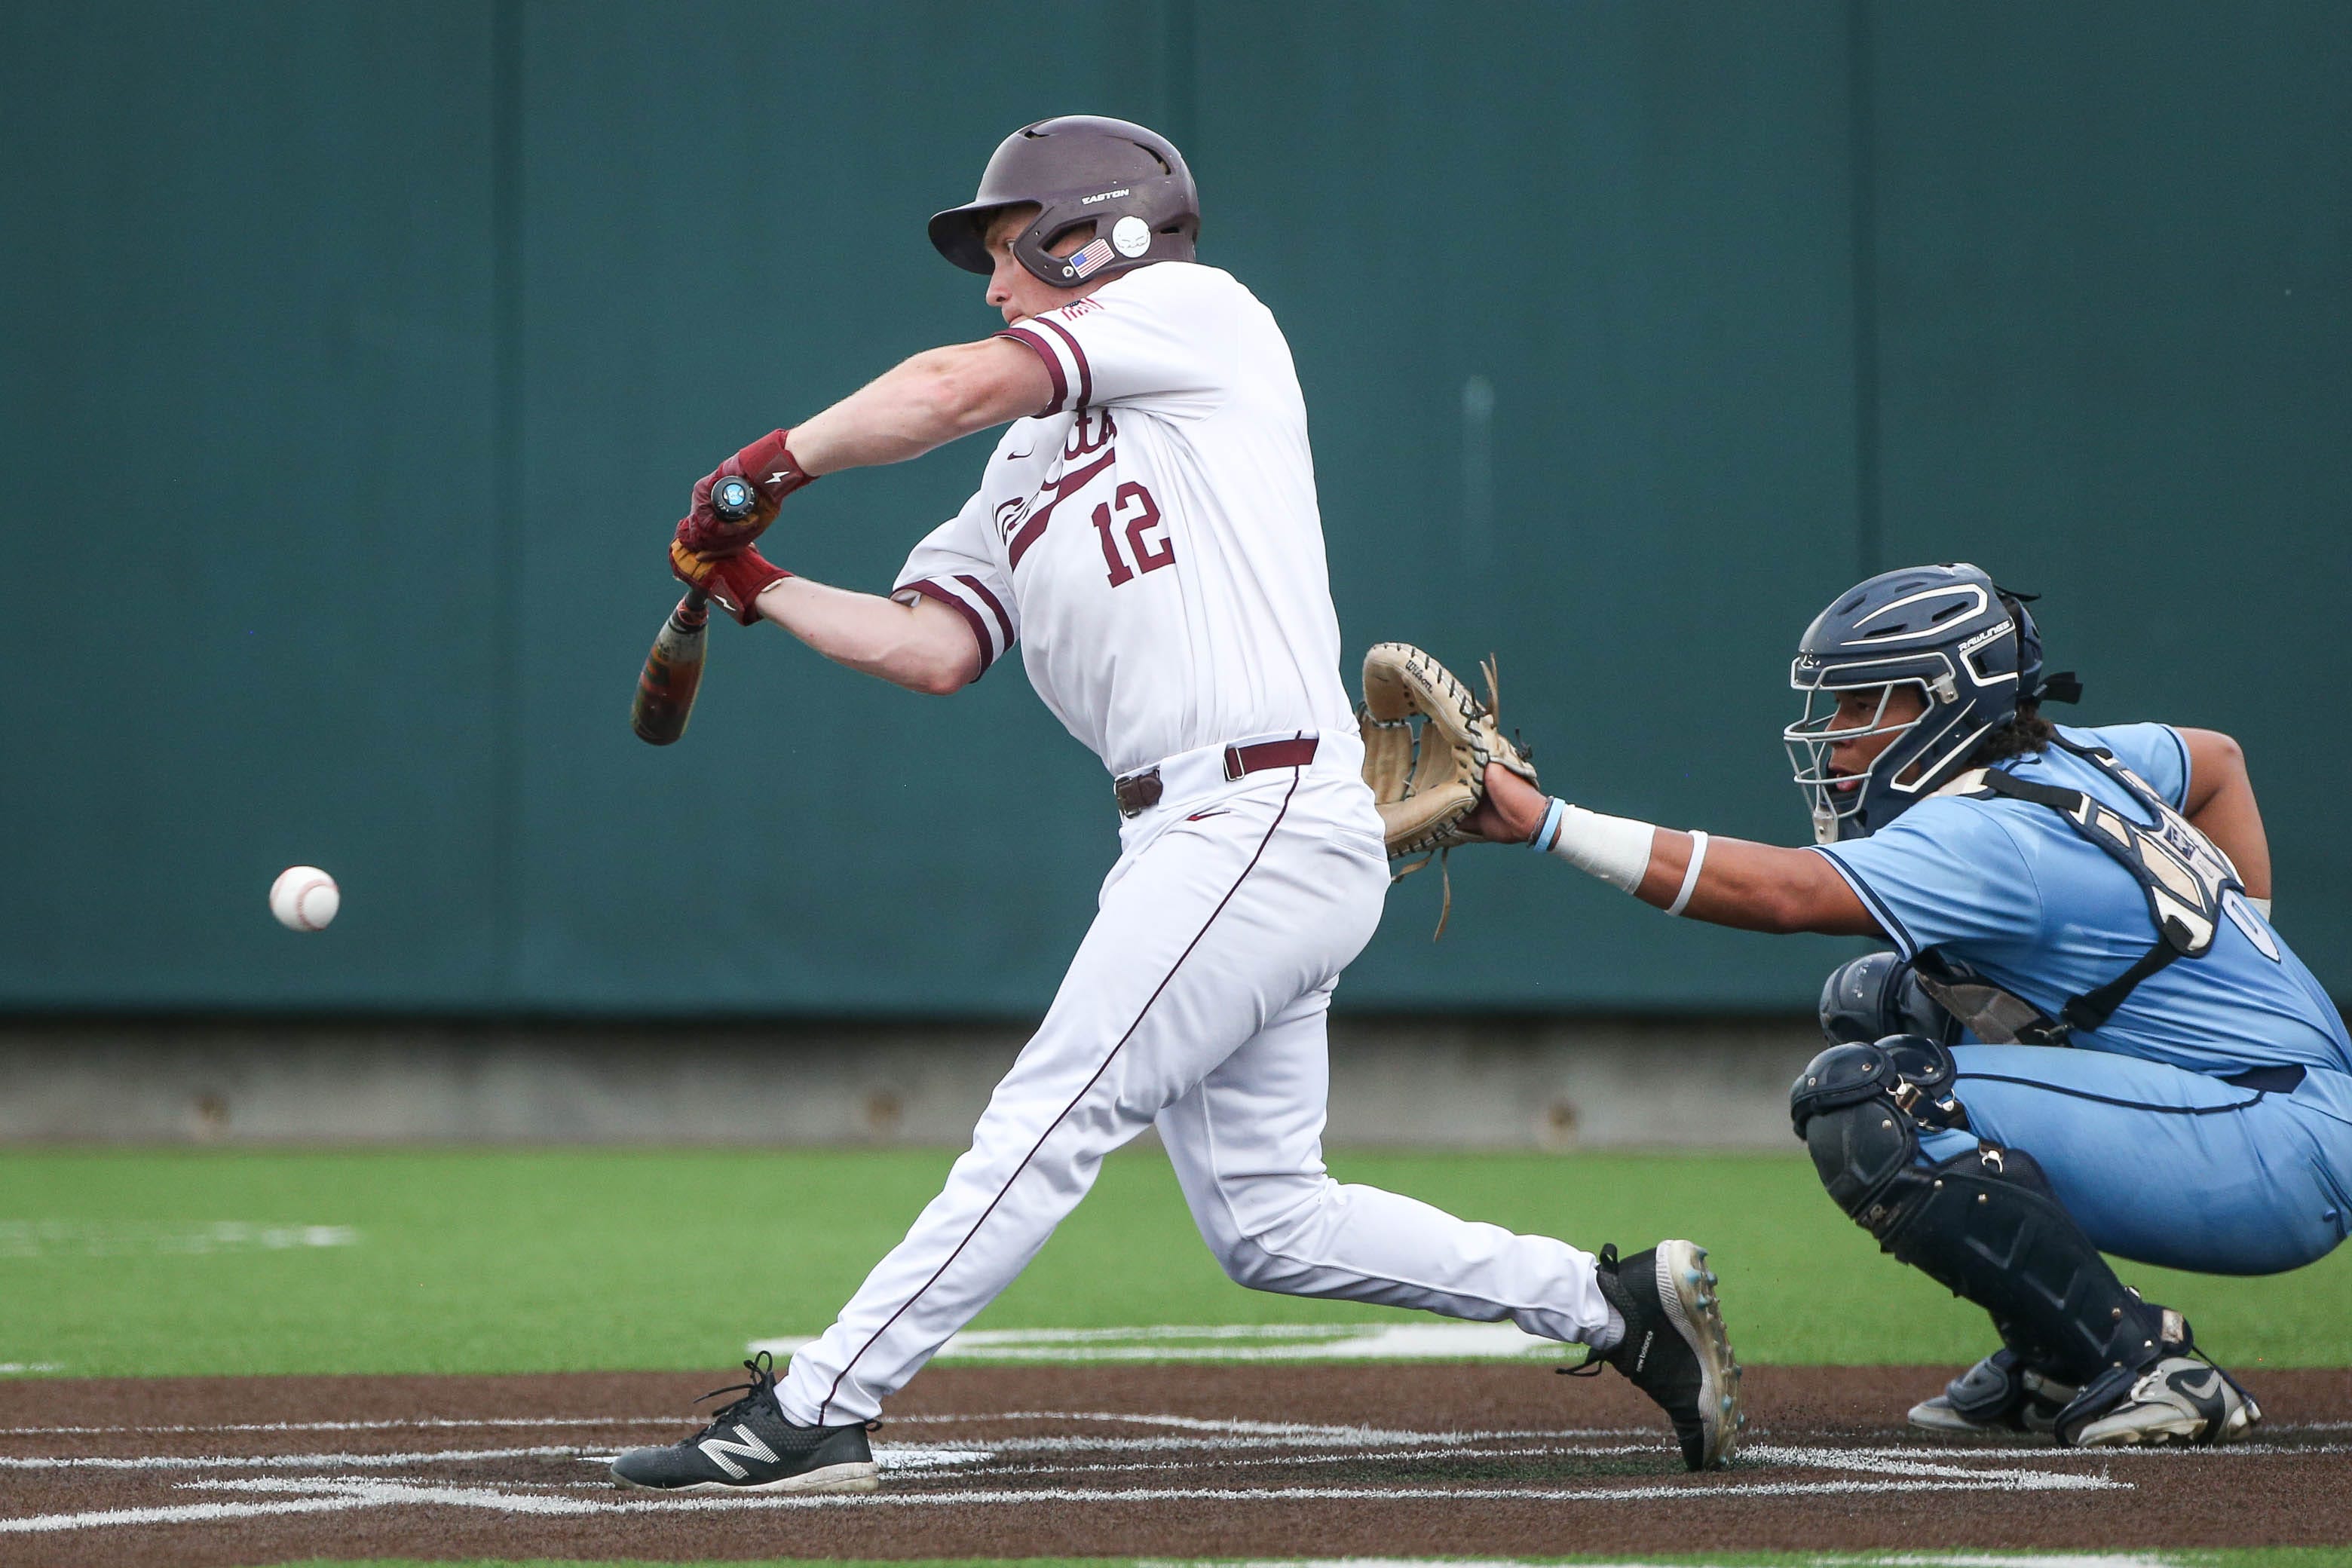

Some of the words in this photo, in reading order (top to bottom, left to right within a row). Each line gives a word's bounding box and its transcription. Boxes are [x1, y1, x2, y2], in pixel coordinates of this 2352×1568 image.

[1080, 188, 1130, 205] EASTON
[1091, 480, 1176, 588] 12
[1957, 620, 2011, 651] RAWLINGS
